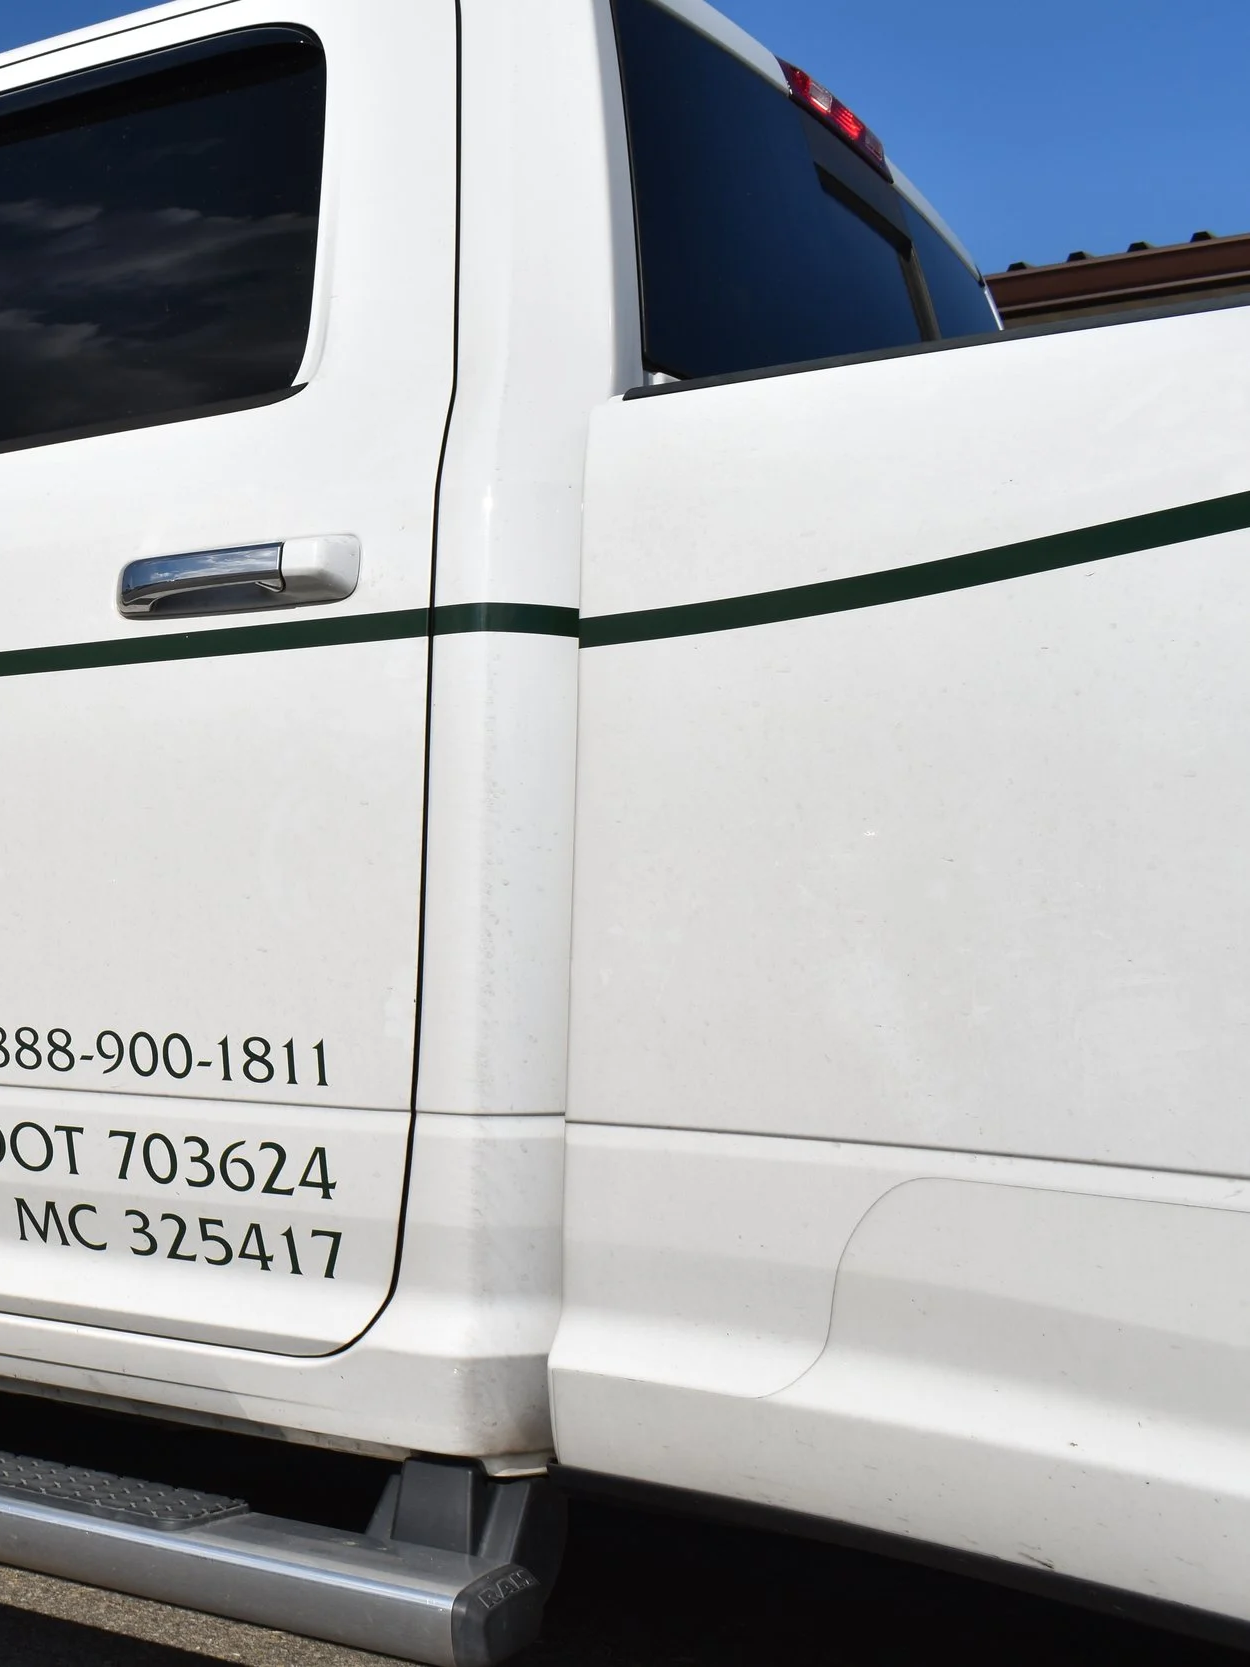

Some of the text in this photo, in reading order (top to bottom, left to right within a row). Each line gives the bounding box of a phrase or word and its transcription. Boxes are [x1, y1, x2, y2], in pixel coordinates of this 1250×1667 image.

[108, 1129, 337, 1200] 703624
[14, 1197, 343, 1279] MC 325417
